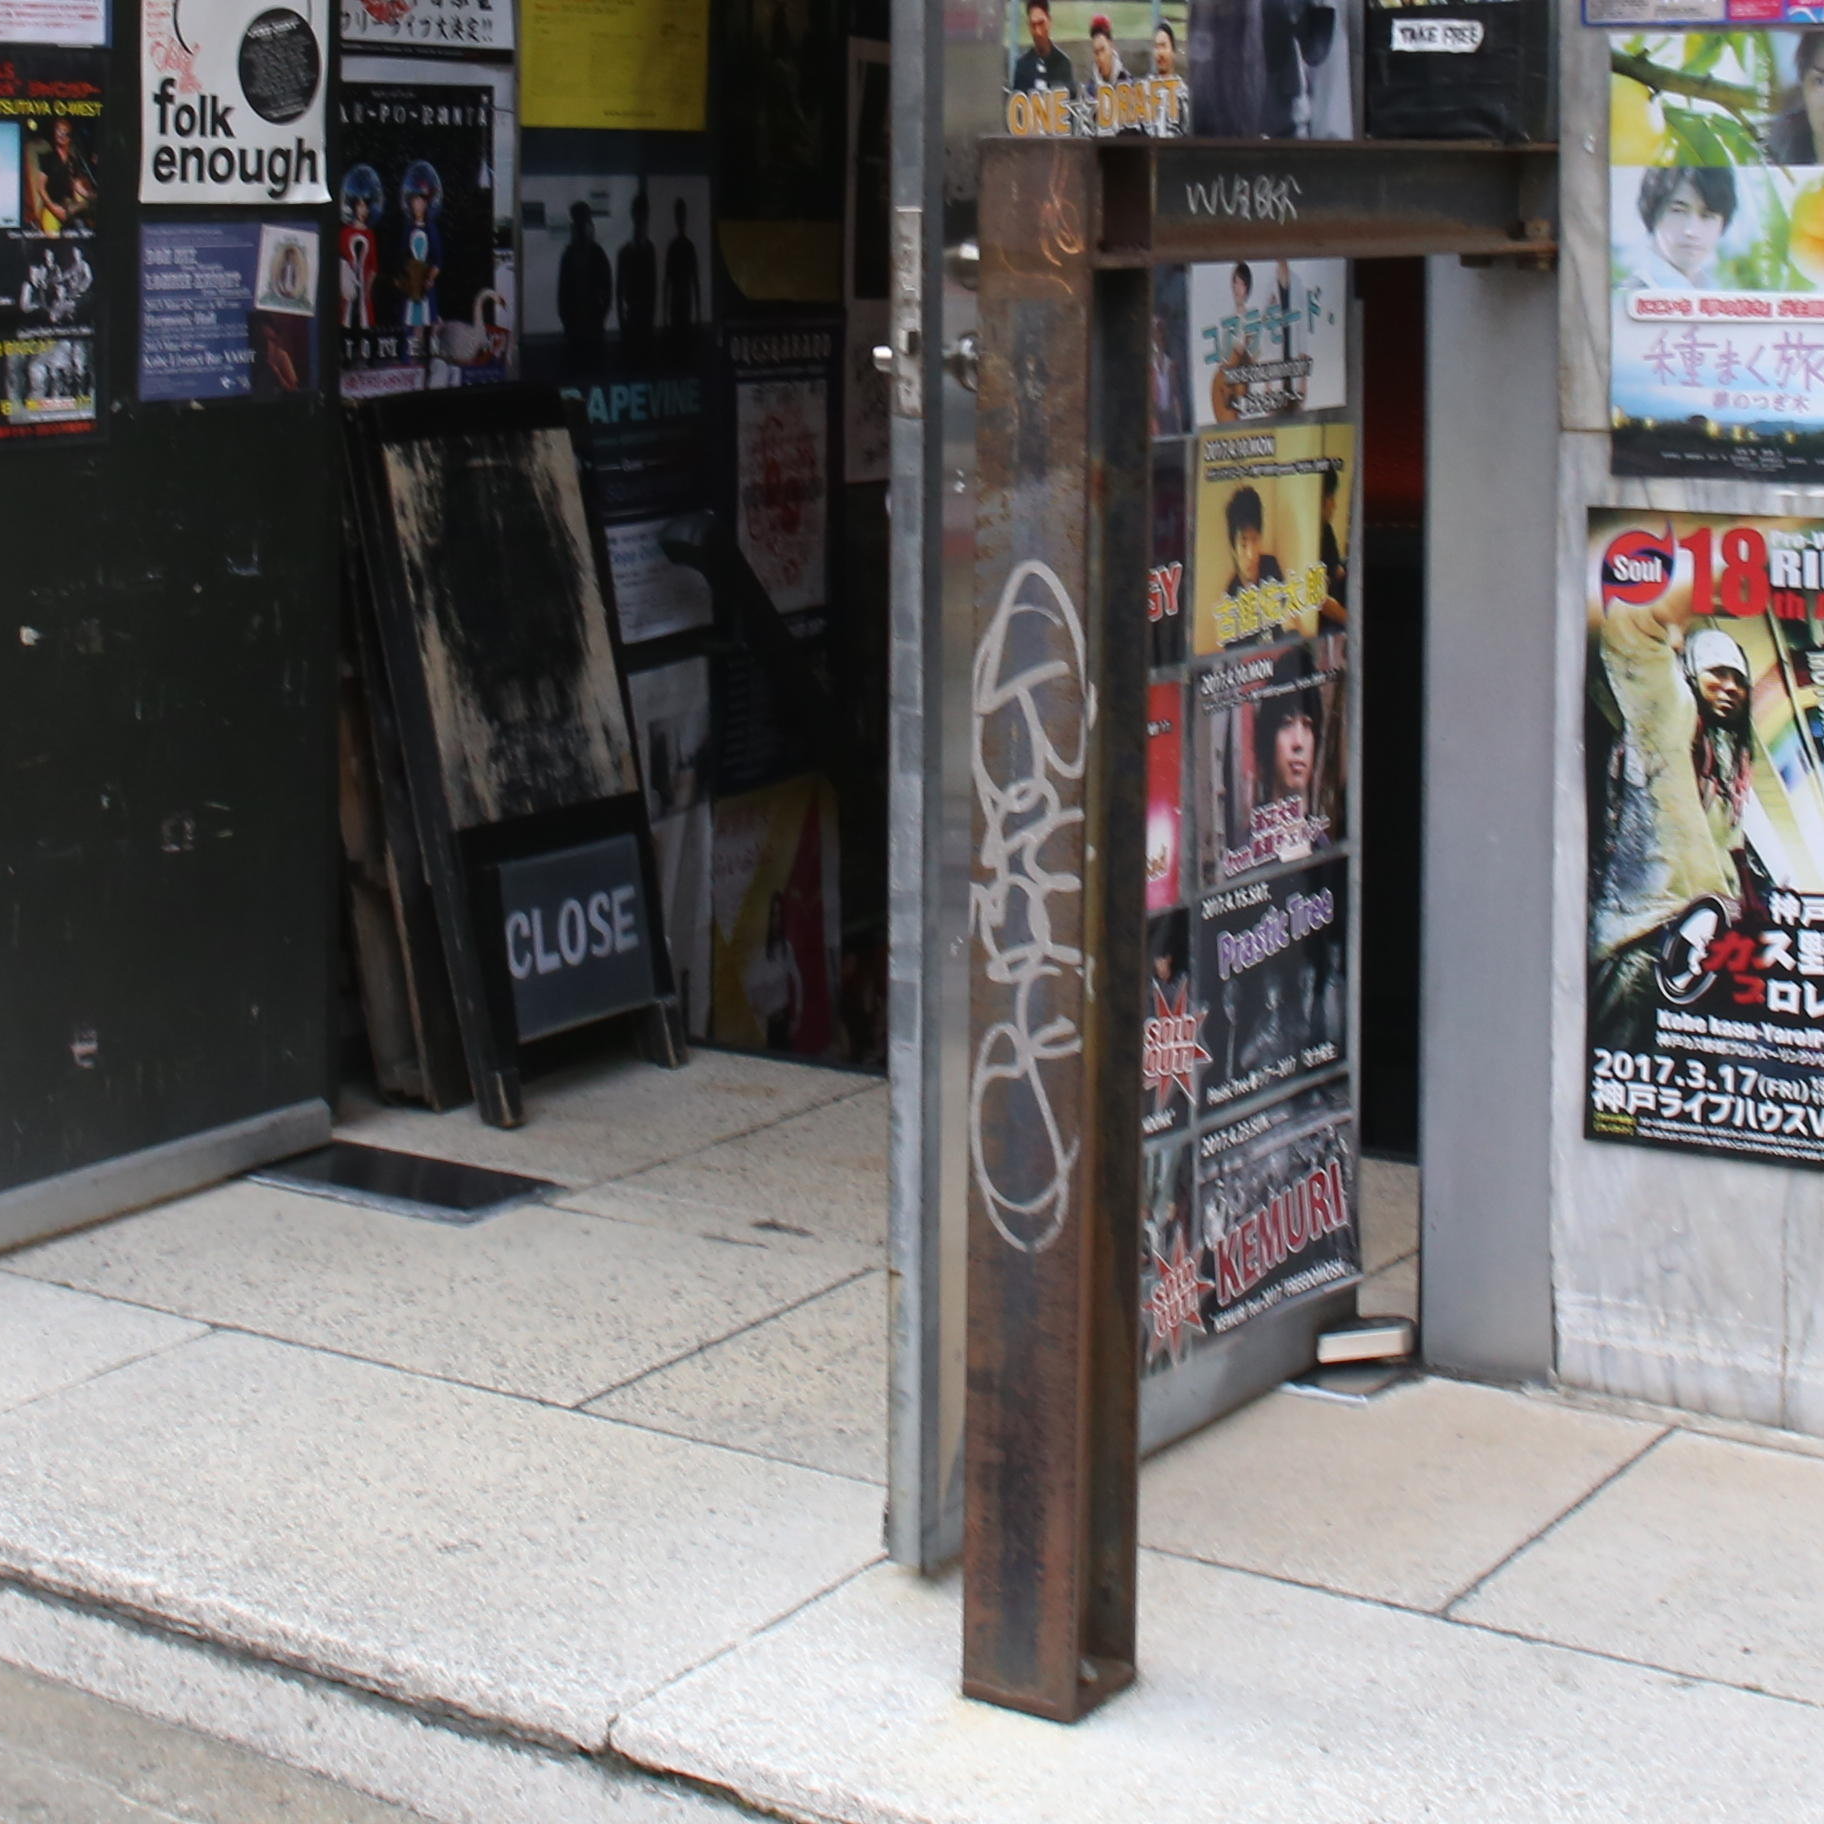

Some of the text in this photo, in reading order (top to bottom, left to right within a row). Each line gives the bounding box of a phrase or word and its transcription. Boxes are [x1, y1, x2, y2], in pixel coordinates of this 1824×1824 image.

[1397, 23, 1480, 46] TAKE FREE
[154, 79, 236, 139] folk
[1007, 77, 1186, 137] ONE DRAFT
[153, 137, 319, 200] enough
[1713, 391, 1810, 413] 夢のつぎ木
[1612, 554, 1662, 585] Soul
[1678, 527, 1768, 619] 18
[1774, 592, 1808, 622] th
[504, 884, 640, 981] CLOSE
[1283, 887, 1337, 937] Tree
[1142, 1013, 1199, 1046] SOLD
[1593, 1048, 1809, 1104] 2017.3.17(FRI)
[1213, 1162, 1349, 1305] KEMURI
